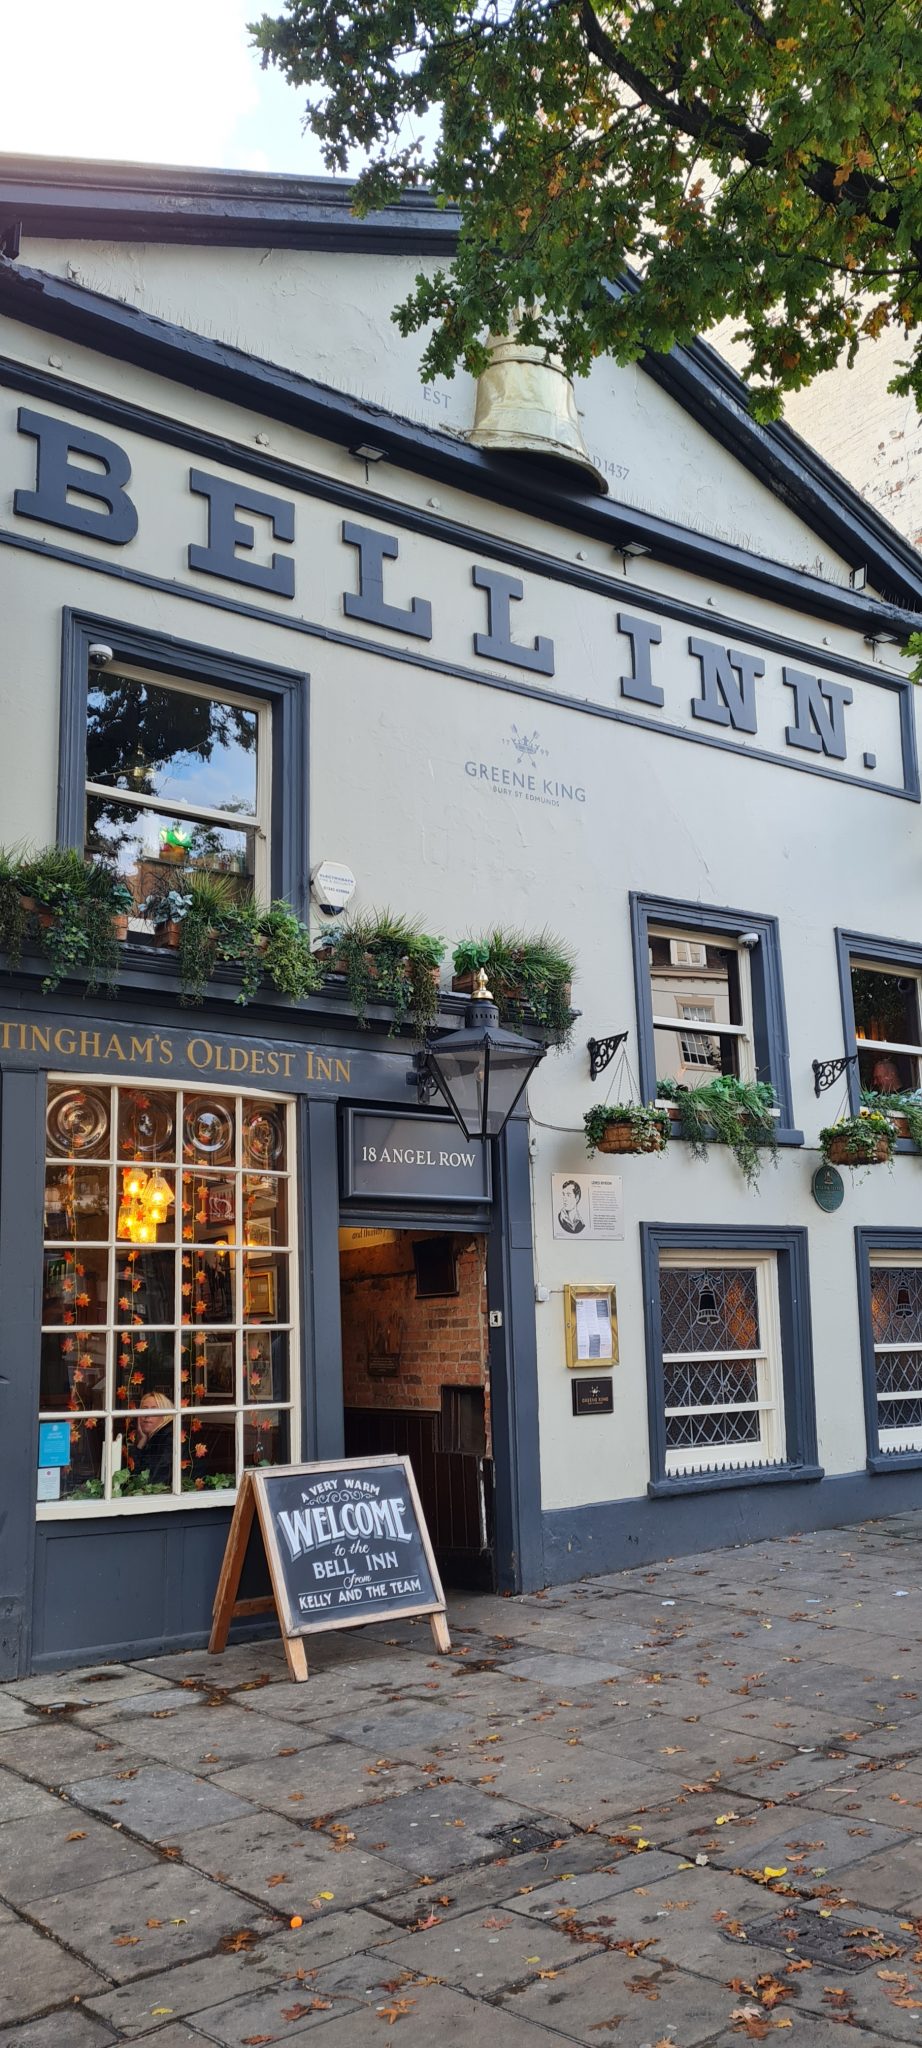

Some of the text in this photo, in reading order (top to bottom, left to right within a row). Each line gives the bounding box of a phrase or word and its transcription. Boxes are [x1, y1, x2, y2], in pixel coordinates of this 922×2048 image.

[423, 386, 452, 409] EST
[604, 460, 630, 480] 1437
[13, 406, 554, 677] BELL
[464, 761, 586, 802] GREENE KING
[492, 785, 560, 807] BURY ST EDMUNDS
[187, 1038, 296, 1078] OLDEST
[305, 1051, 351, 1083] INN
[362, 1146, 476, 1167] 18 ANGEL ROW
[301, 1479, 380, 1503] A VERY WARM
[277, 1498, 412, 1562] WELCOME
[332, 1539, 370, 1557] to the
[312, 1551, 399, 1580] BELL INN
[343, 1573, 372, 1590] from
[298, 1578, 421, 1610] KELLY AND THE TEAM
